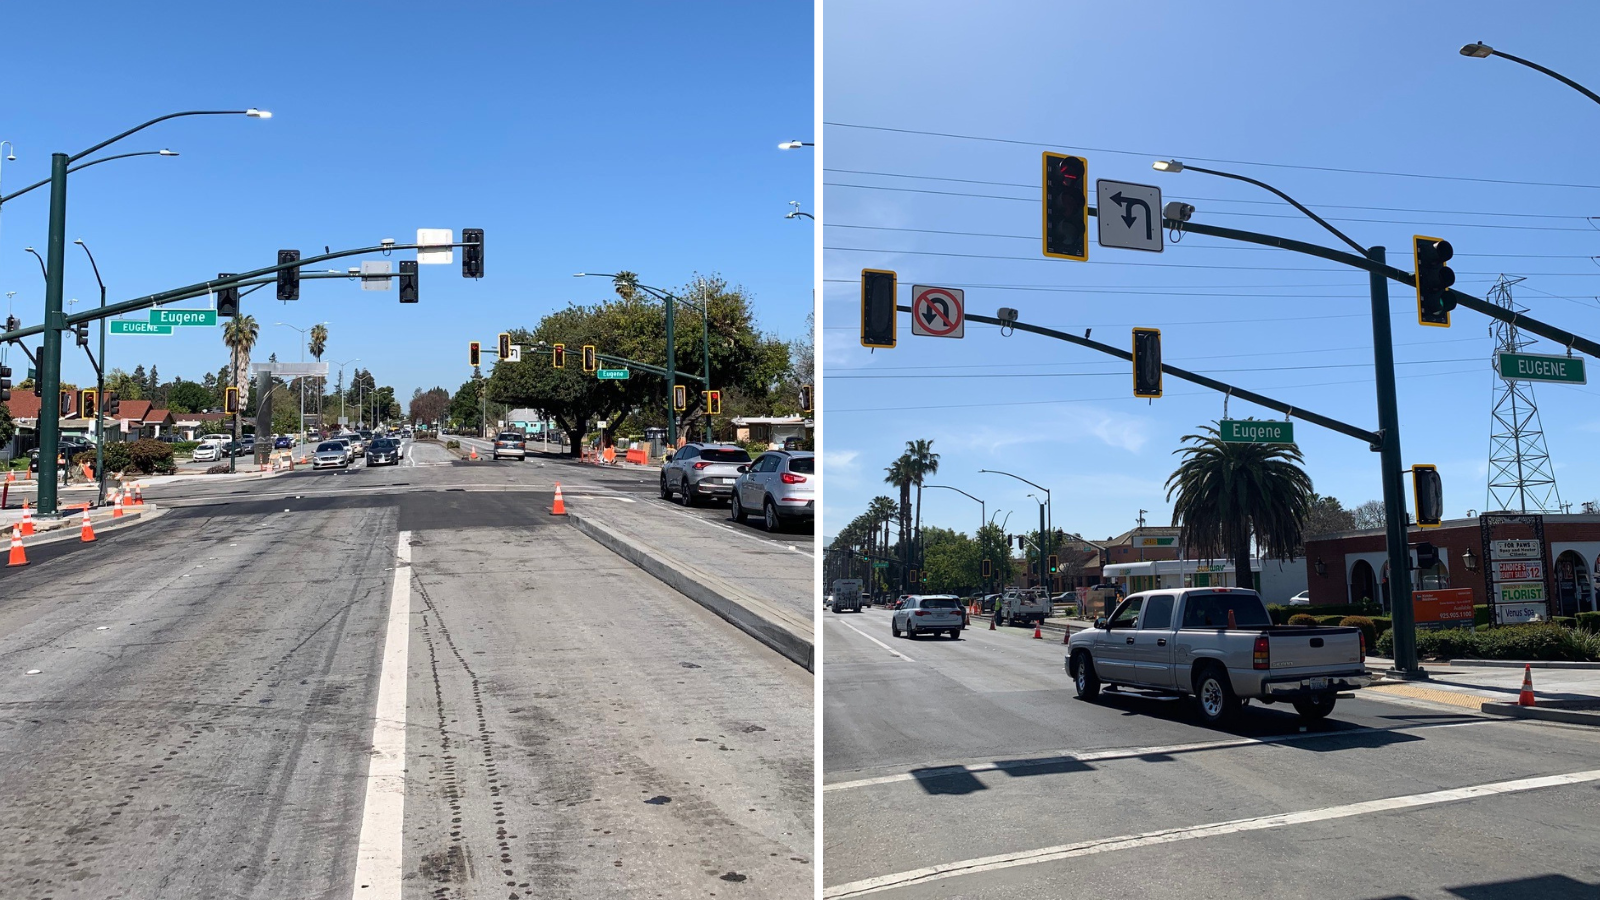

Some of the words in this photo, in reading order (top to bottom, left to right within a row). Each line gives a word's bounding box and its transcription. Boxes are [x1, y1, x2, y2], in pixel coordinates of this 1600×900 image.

[161, 311, 205, 325] Eugene
[123, 323, 159, 331] EUGENE
[1518, 360, 1567, 377] EUGENE
[603, 370, 624, 378] Eugene
[1233, 423, 1281, 442] Eugene
[1196, 565, 1226, 573] SUBWAY
[1501, 589, 1542, 601] FLORIST
[1505, 608, 1522, 617] Venus
[1523, 608, 1534, 617] Spa
